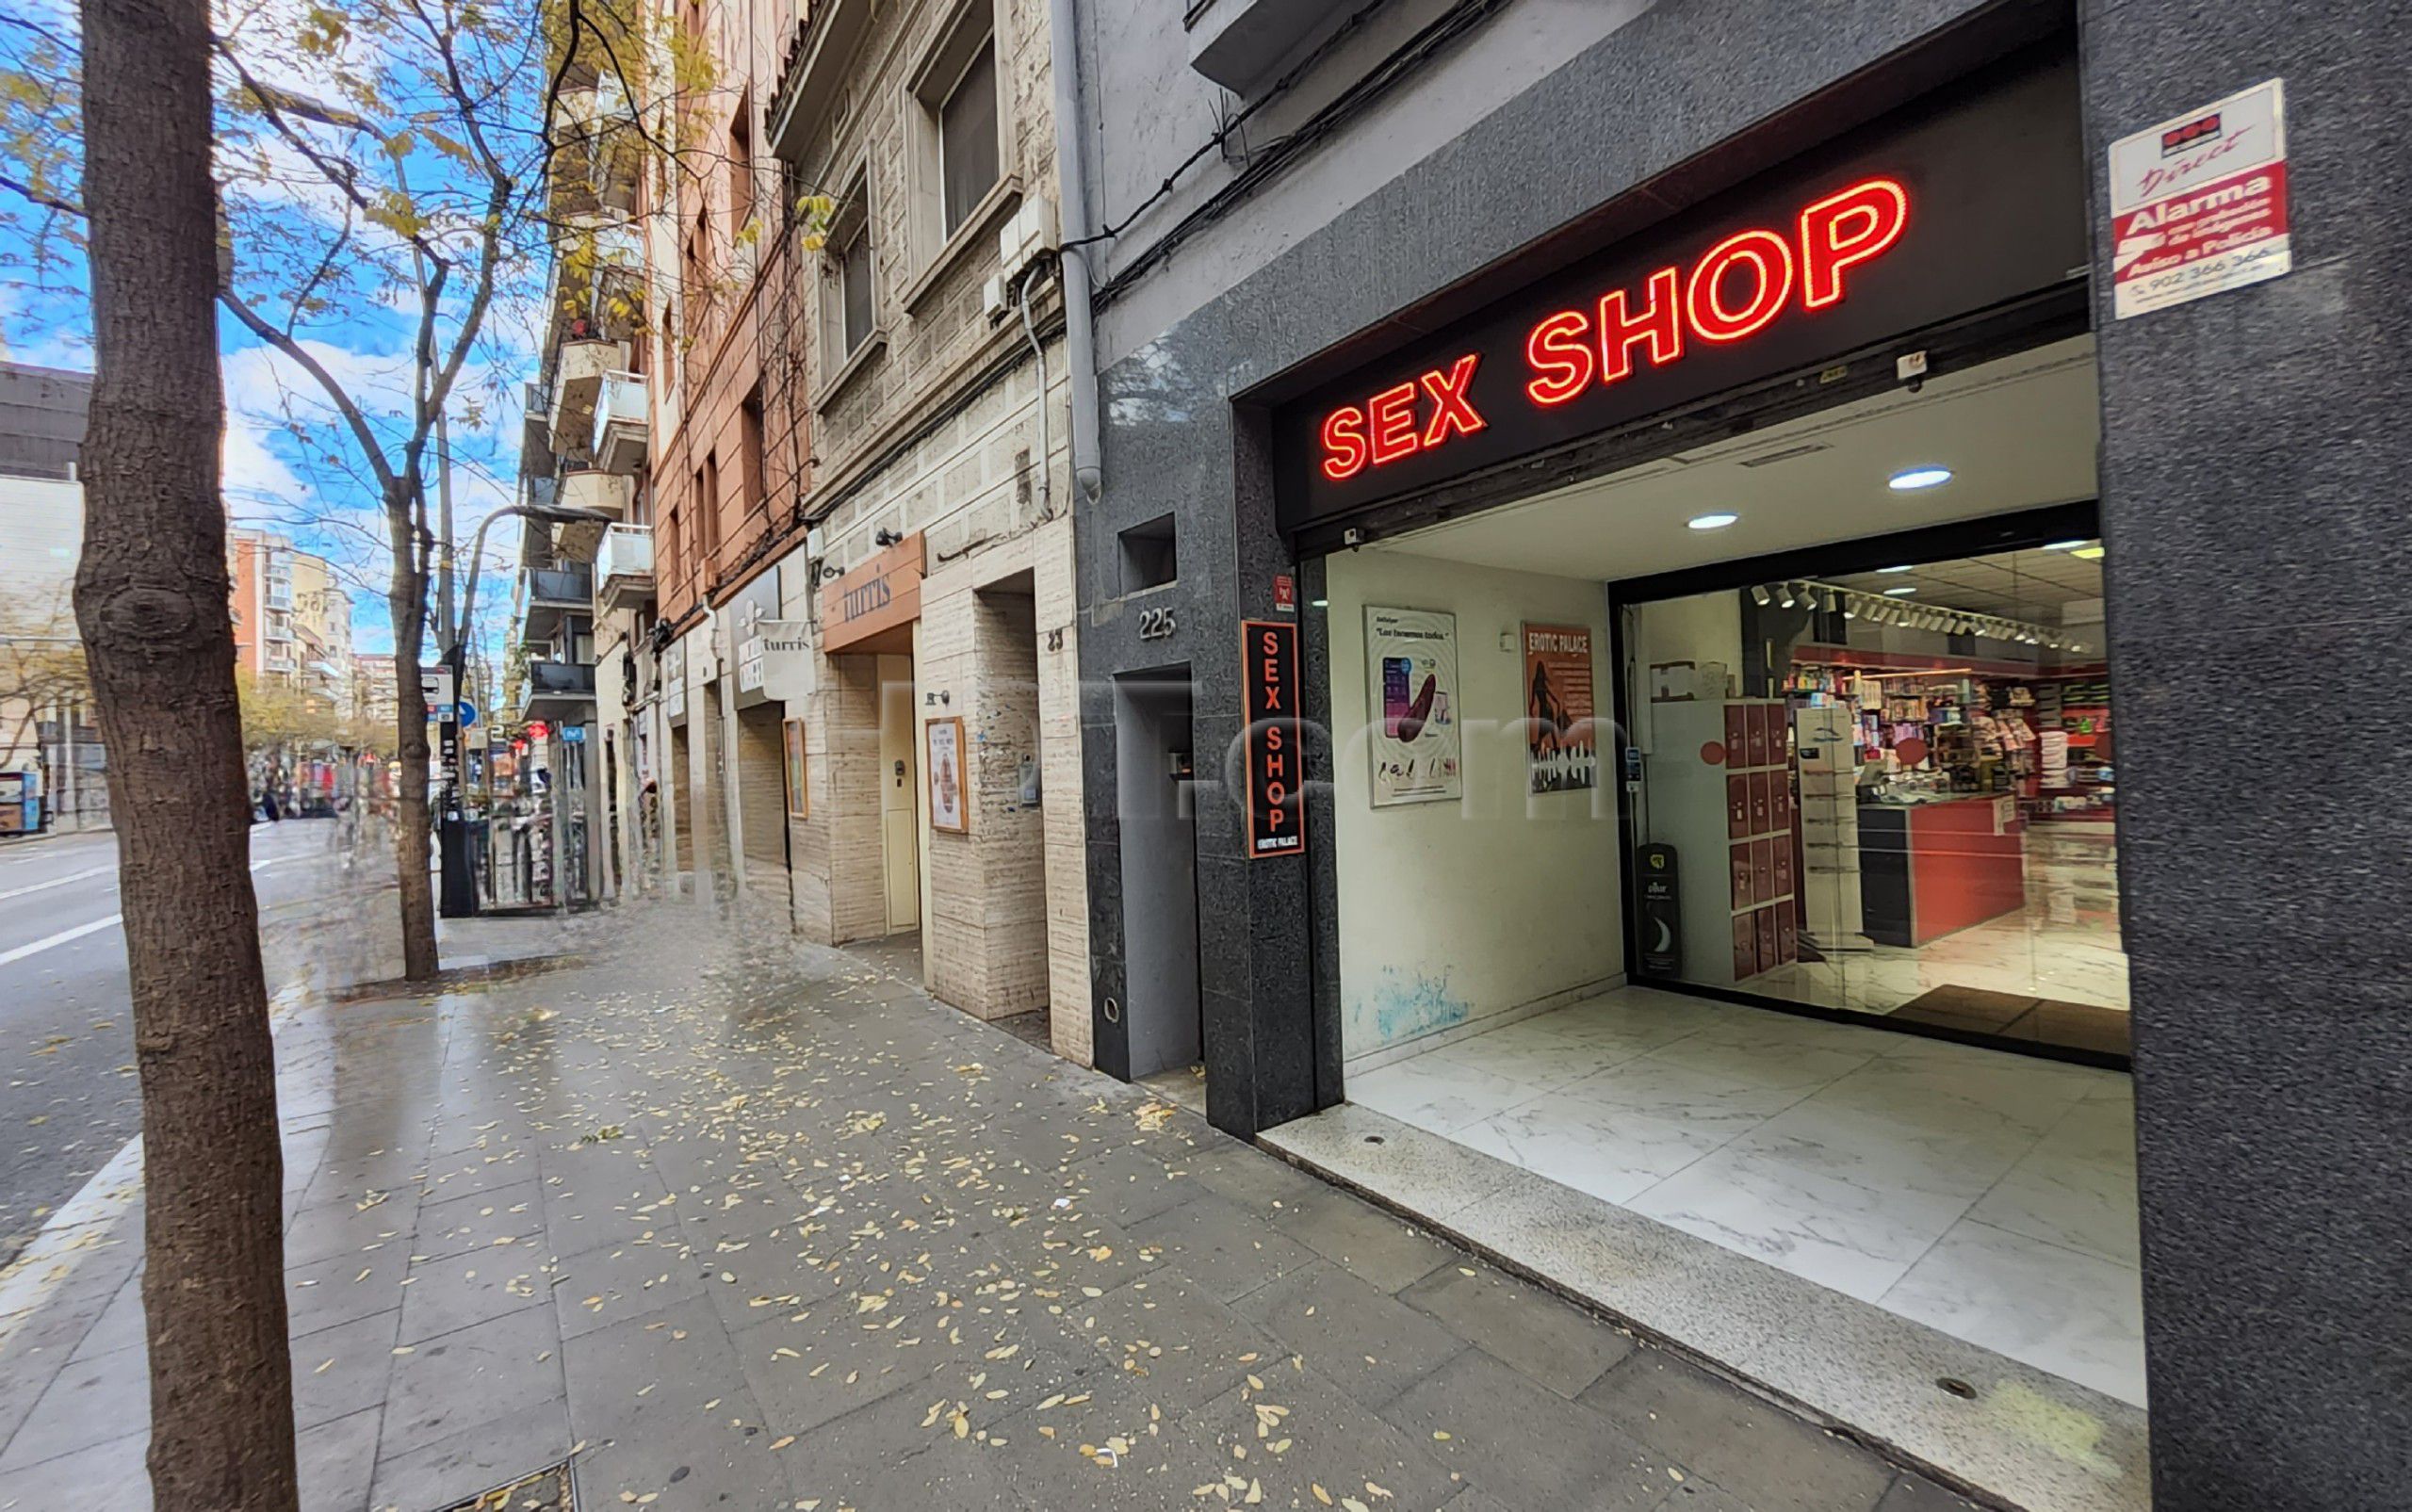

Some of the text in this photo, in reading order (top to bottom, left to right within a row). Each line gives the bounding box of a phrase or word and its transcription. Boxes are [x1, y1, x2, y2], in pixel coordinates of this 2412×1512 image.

[2126, 175, 2272, 236] Alarma
[2149, 272, 2184, 291] 902
[2190, 259, 2225, 280] 366
[2232, 247, 2269, 267] 366
[2184, 248, 2200, 260] a
[1320, 176, 1911, 481] SEX SHOP
[843, 564, 891, 624] turris
[763, 637, 809, 651] turris
[1139, 608, 1176, 640] 225
[1528, 632, 1589, 656] EROTIC PALACE
[1263, 631, 1284, 833] SEX SHOP
